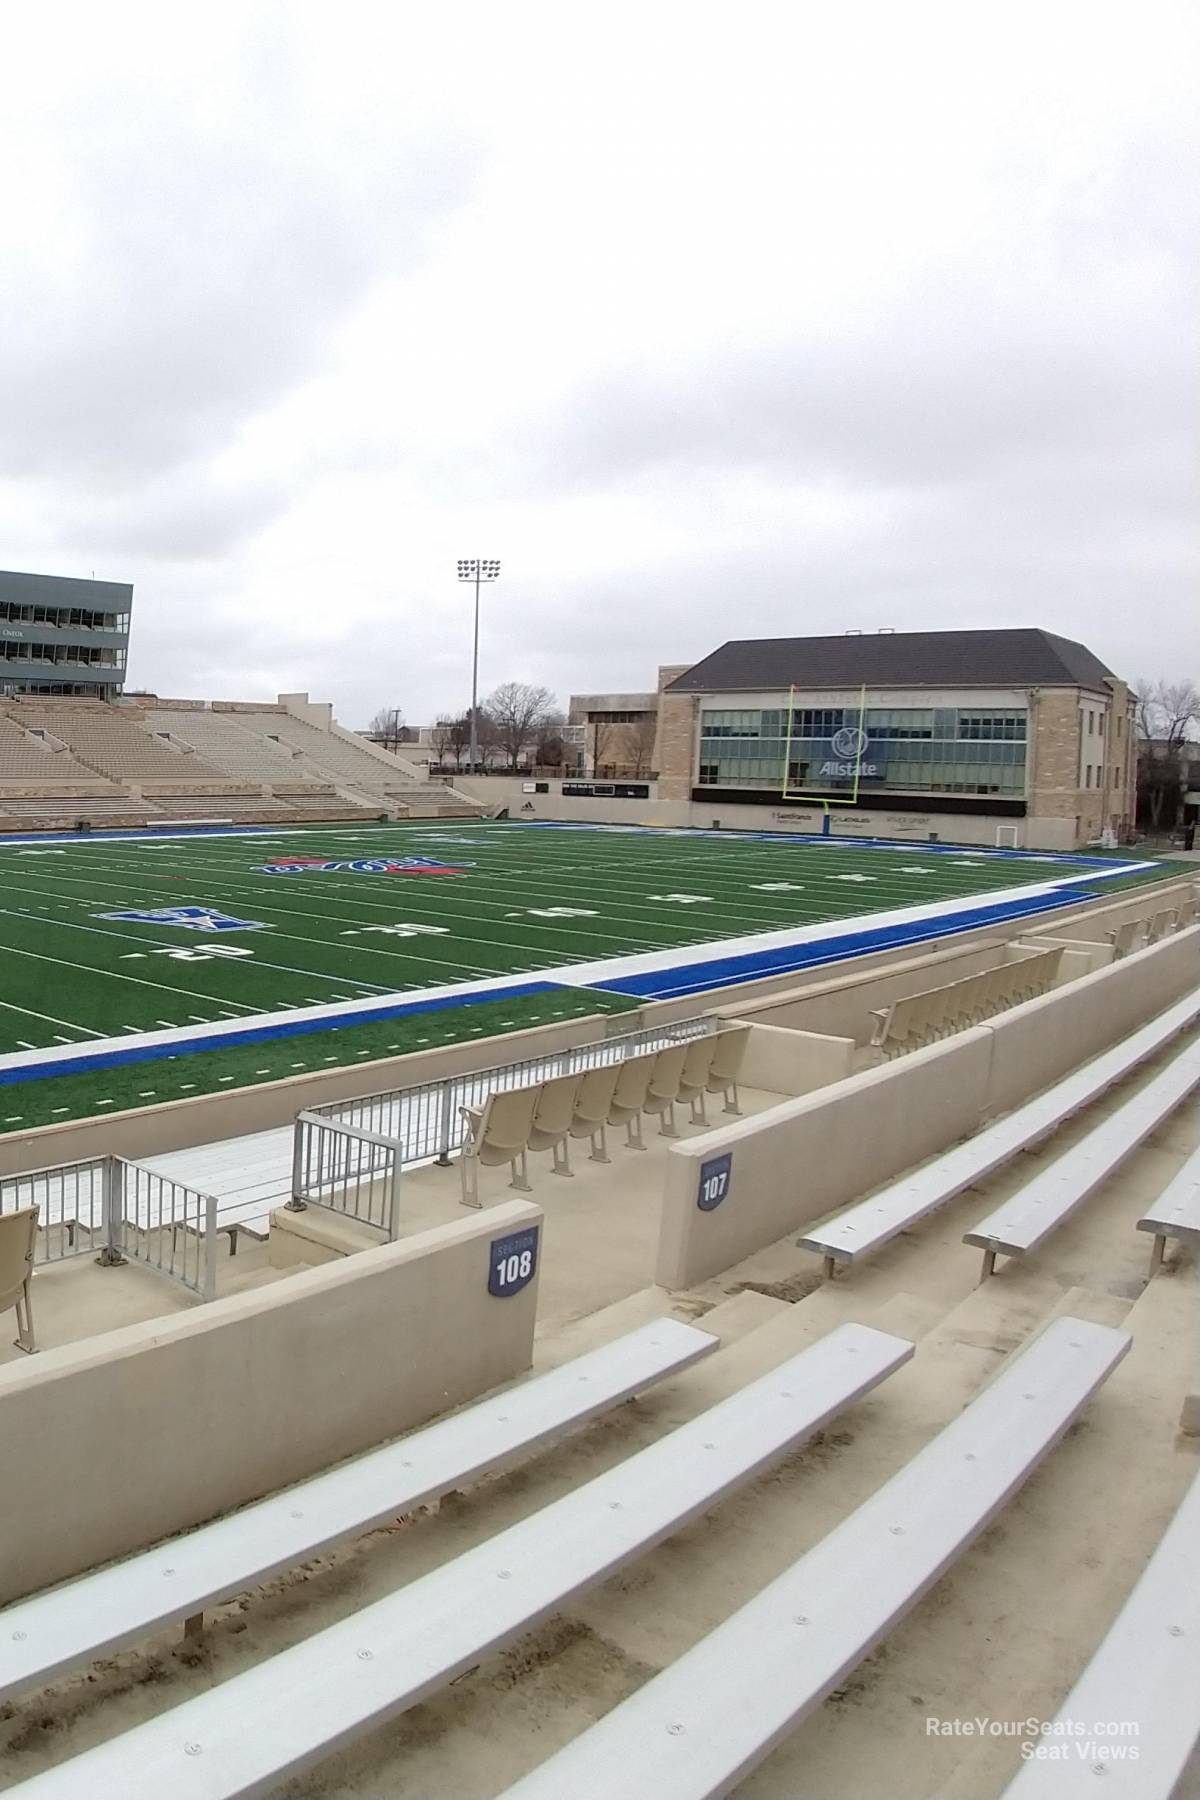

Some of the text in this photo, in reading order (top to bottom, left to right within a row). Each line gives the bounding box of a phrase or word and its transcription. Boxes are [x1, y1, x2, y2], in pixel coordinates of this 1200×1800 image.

[819, 761, 878, 776] Allstate
[359, 923, 451, 937] 30
[149, 944, 255, 961] 20
[703, 1172, 727, 1201] 107
[497, 1250, 532, 1286] 108
